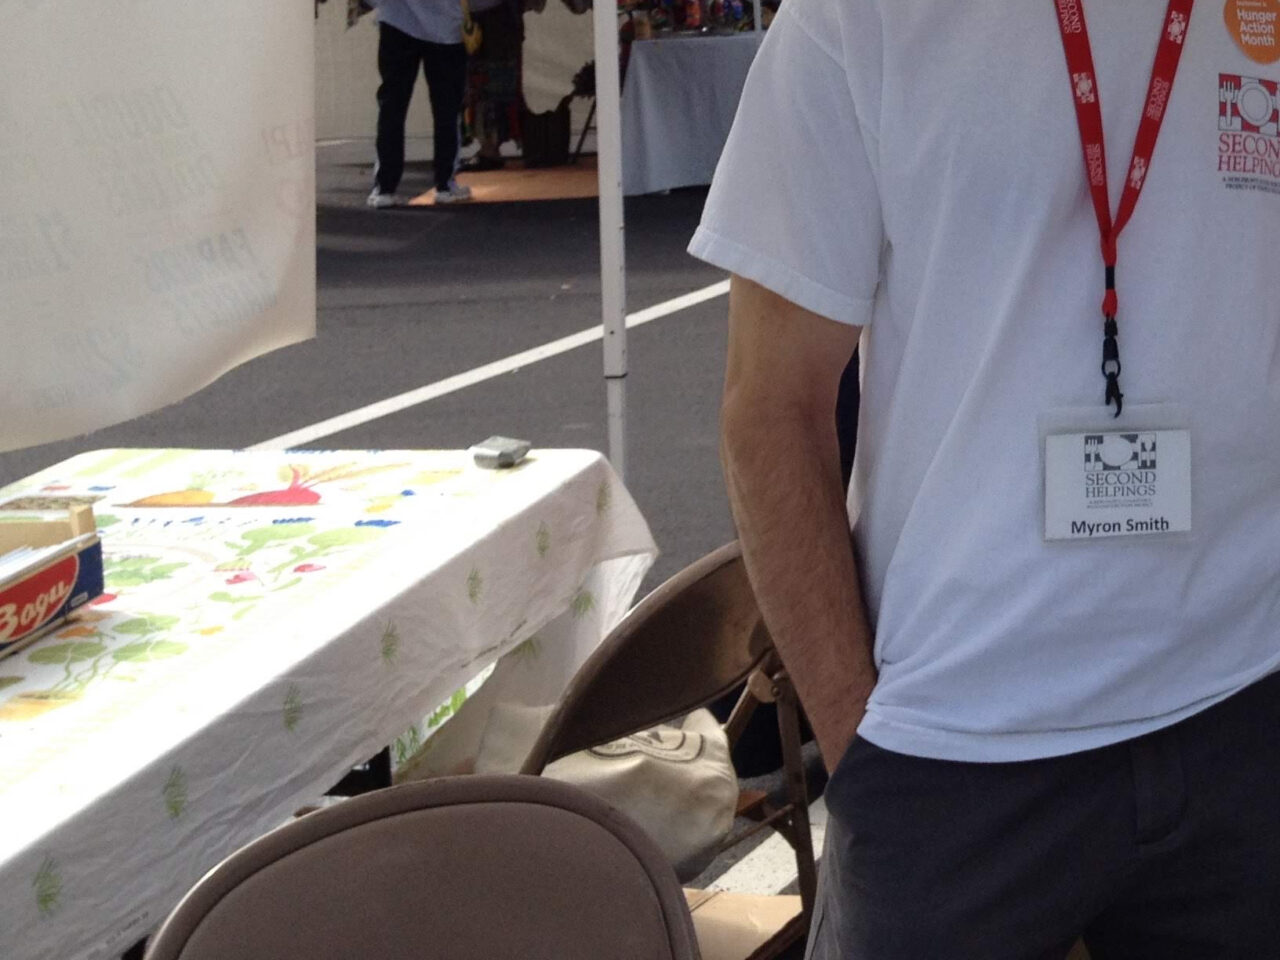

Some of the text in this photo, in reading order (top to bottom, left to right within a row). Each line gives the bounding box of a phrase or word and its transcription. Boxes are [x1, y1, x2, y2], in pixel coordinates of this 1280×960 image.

[1237, 8, 1277, 24] Hunger
[1240, 21, 1275, 35] Action
[1241, 34, 1276, 48] Month
[1146, 77, 1162, 117] SECOND
[1085, 471, 1157, 486] SECOND
[1085, 485, 1156, 498] HELPINGS
[1071, 516, 1169, 536] Myron Smith
